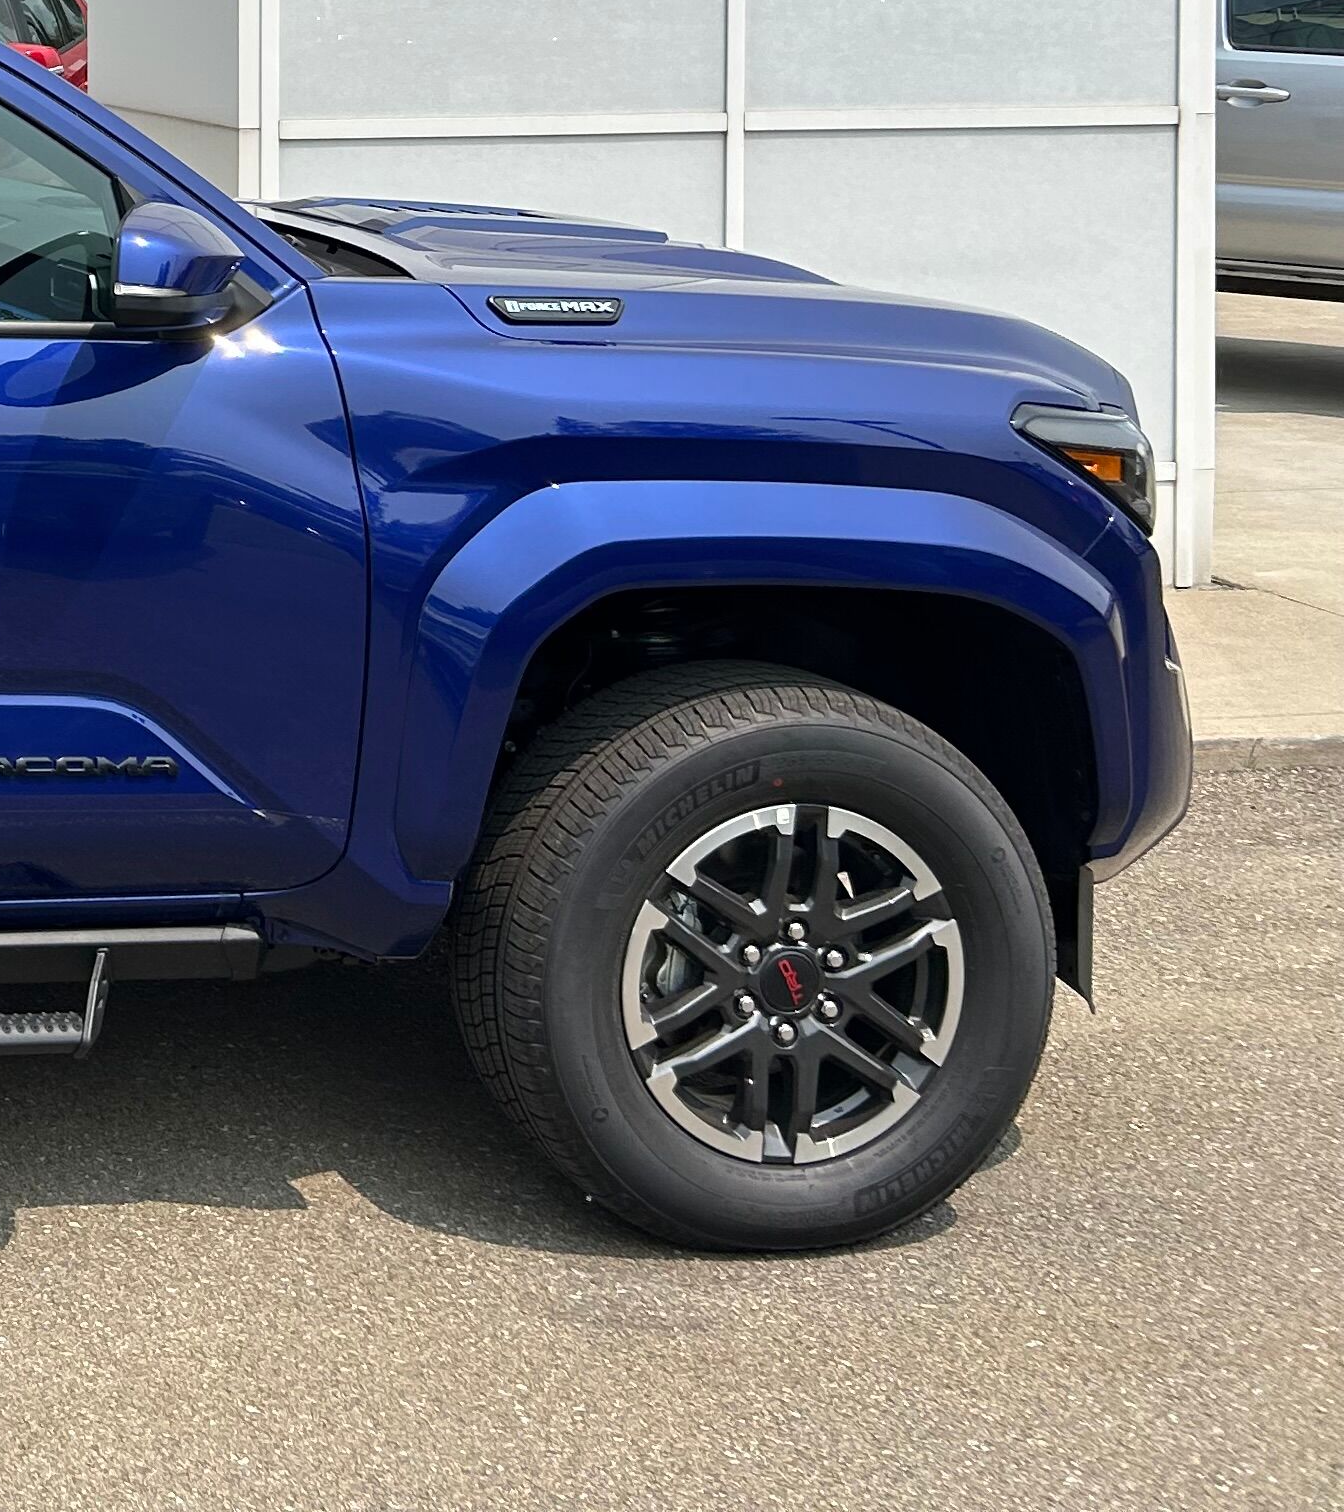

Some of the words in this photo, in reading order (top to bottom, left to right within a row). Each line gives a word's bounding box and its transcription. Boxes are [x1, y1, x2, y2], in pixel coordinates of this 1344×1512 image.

[560, 300, 616, 313] MAX
[635, 763, 754, 856] MICHELIN
[777, 959, 805, 1006] TRD
[858, 1118, 974, 1214] MICHELIN
